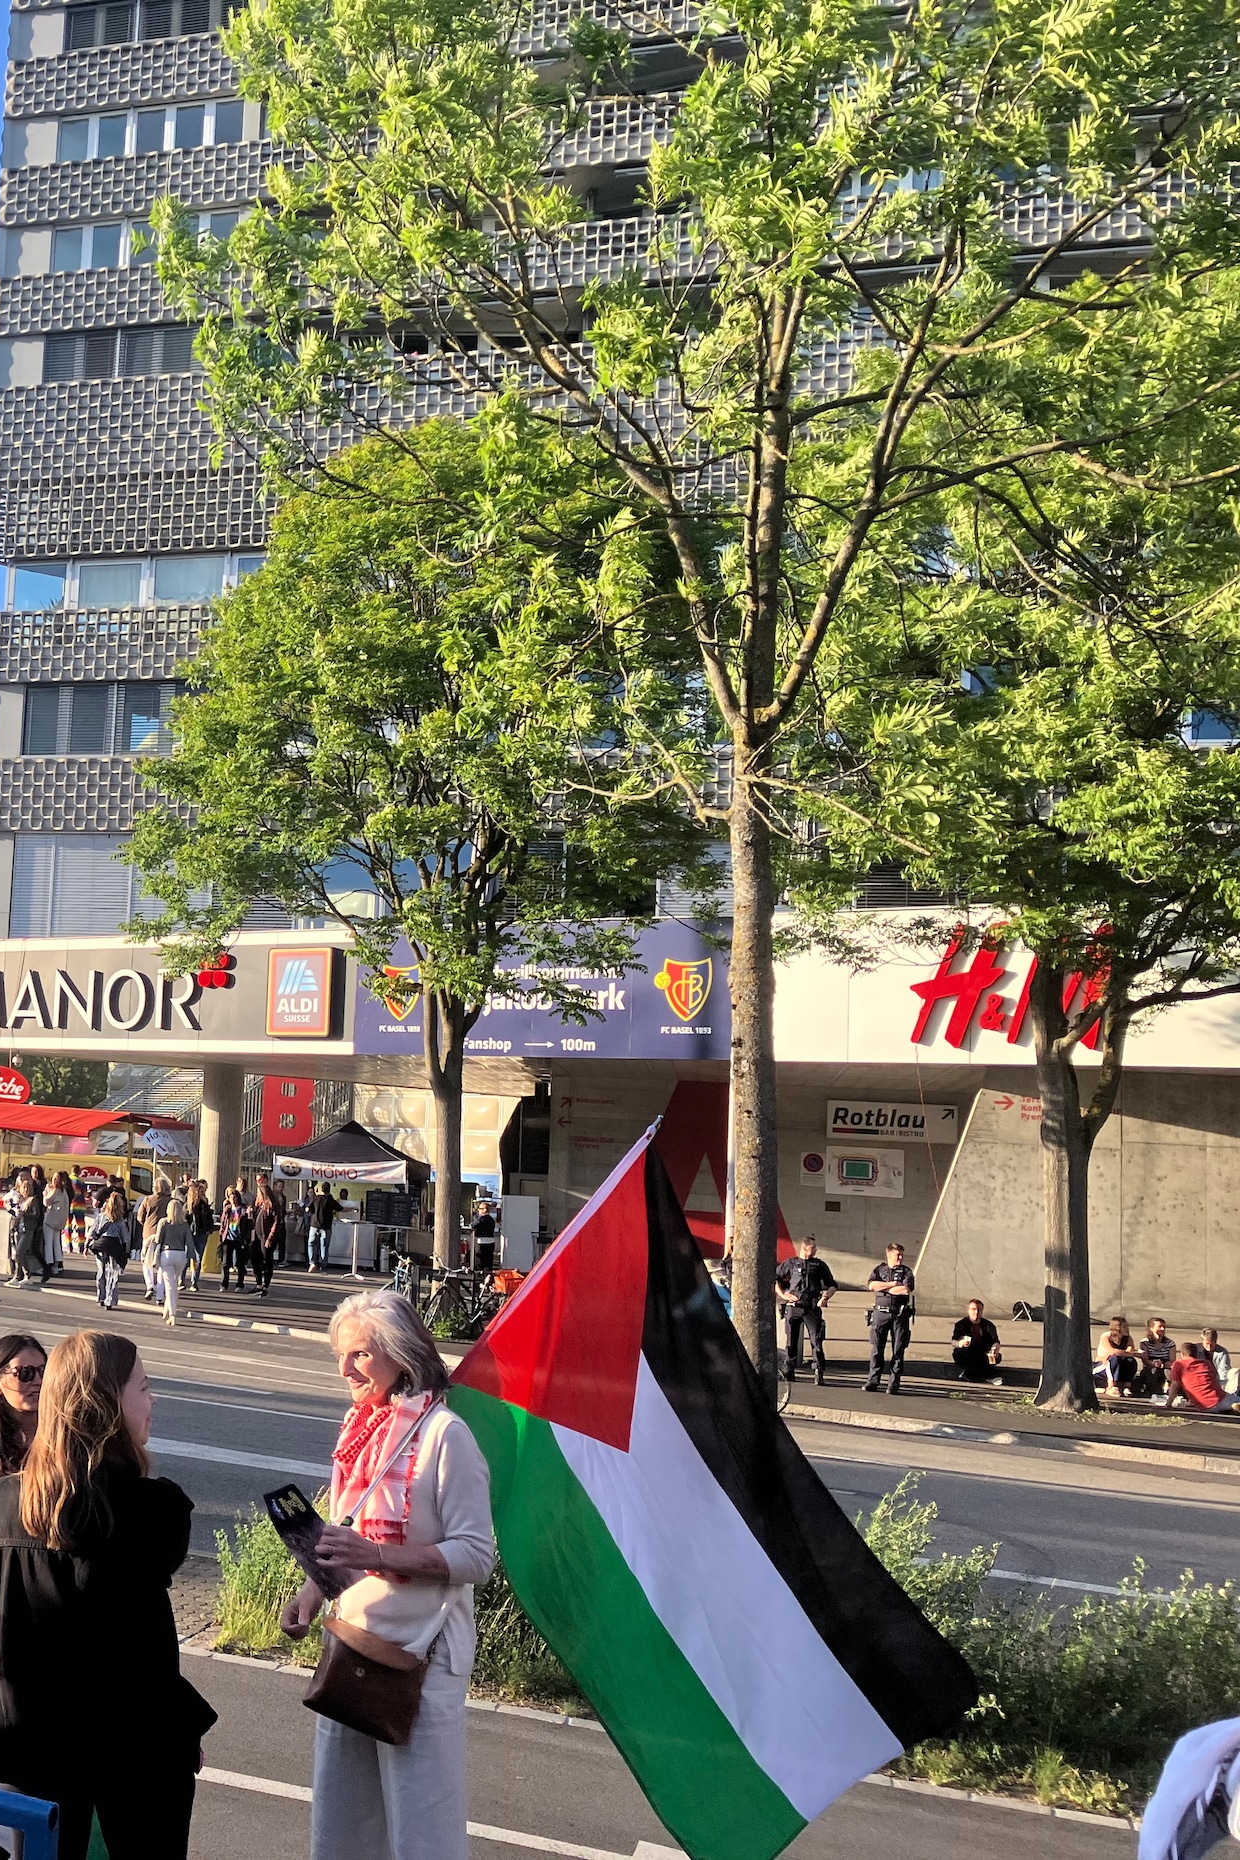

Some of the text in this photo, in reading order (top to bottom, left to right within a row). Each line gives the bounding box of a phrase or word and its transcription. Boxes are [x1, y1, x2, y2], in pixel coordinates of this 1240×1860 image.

[276, 997, 319, 1014] ALDI
[283, 1014, 311, 1023] SUISSE
[378, 1025, 387, 1033] FC
[387, 1025, 406, 1033] BASEL
[661, 1026, 712, 1034] FC BASEL 1893
[463, 1037, 596, 1053] Fanshop 100m
[832, 1107, 926, 1128] Rotblau
[311, 1167, 358, 1180] MOMO
